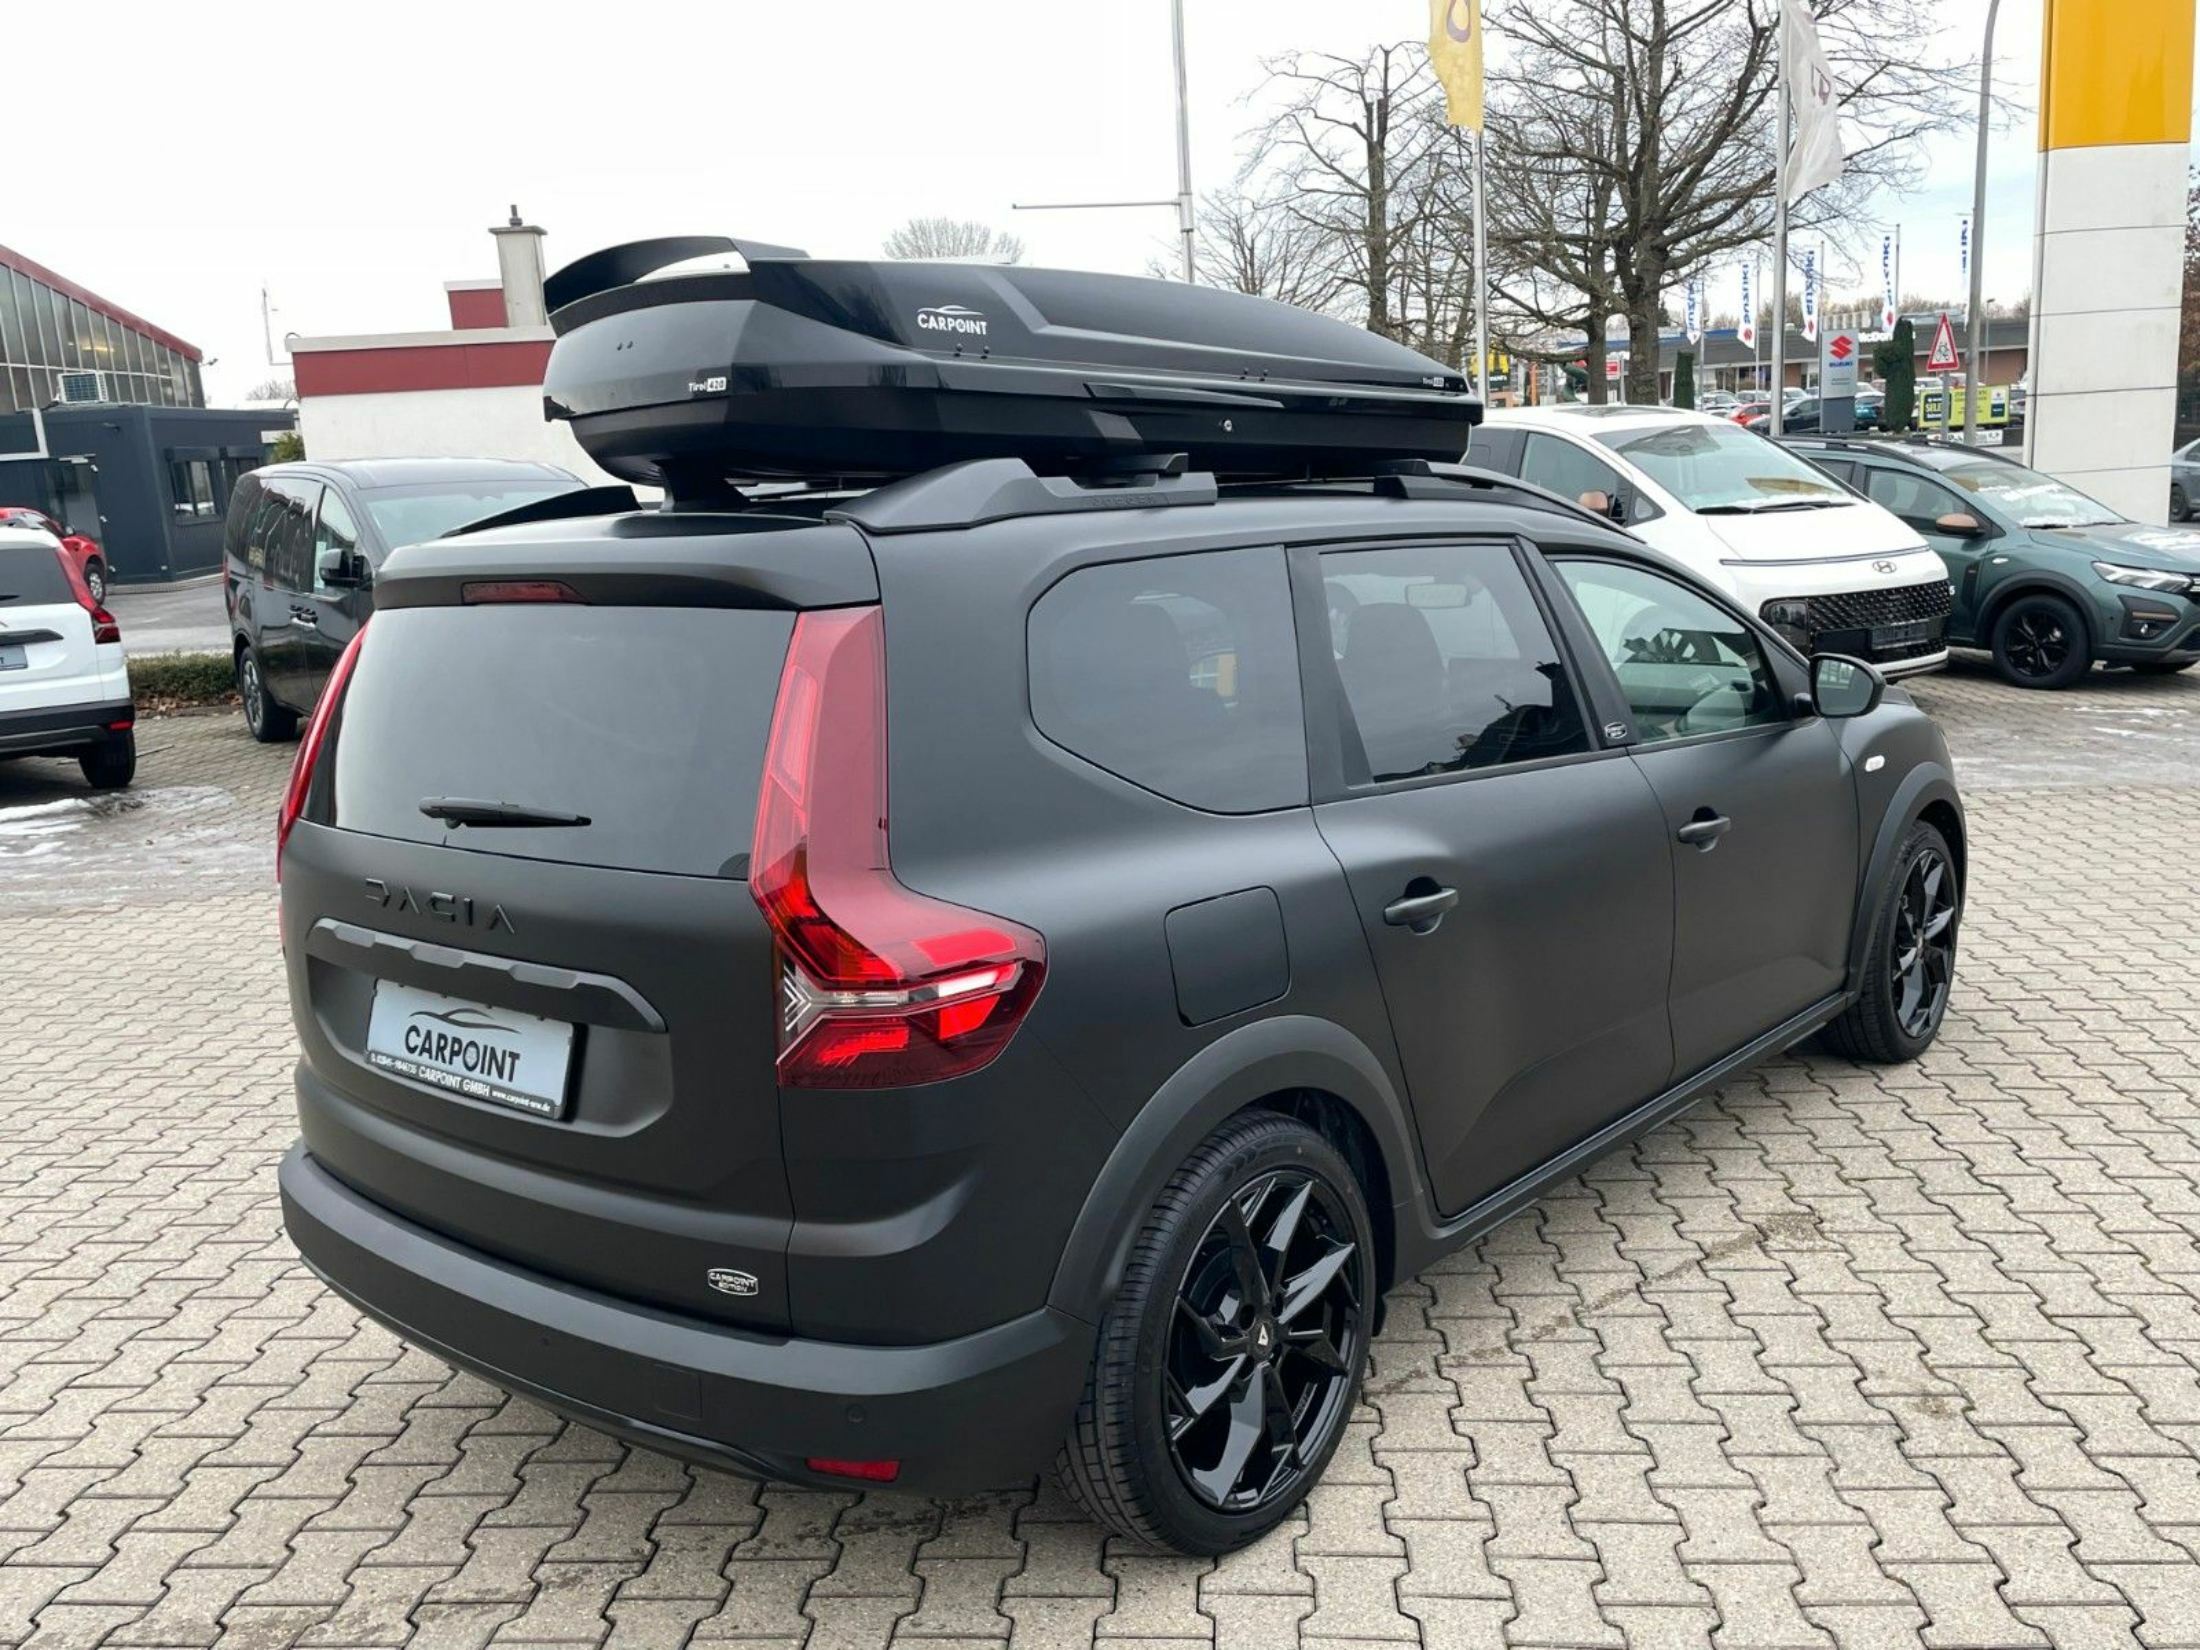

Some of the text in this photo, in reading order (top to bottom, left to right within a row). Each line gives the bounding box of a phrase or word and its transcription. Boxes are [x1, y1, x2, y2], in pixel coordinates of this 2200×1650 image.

[917, 313, 987, 335] CARPOINT
[365, 878, 515, 934] DACIA
[405, 1025, 520, 1082] CARPOINT
[419, 1066, 461, 1088] CARPOINT
[710, 1272, 755, 1287] CARPOINT
